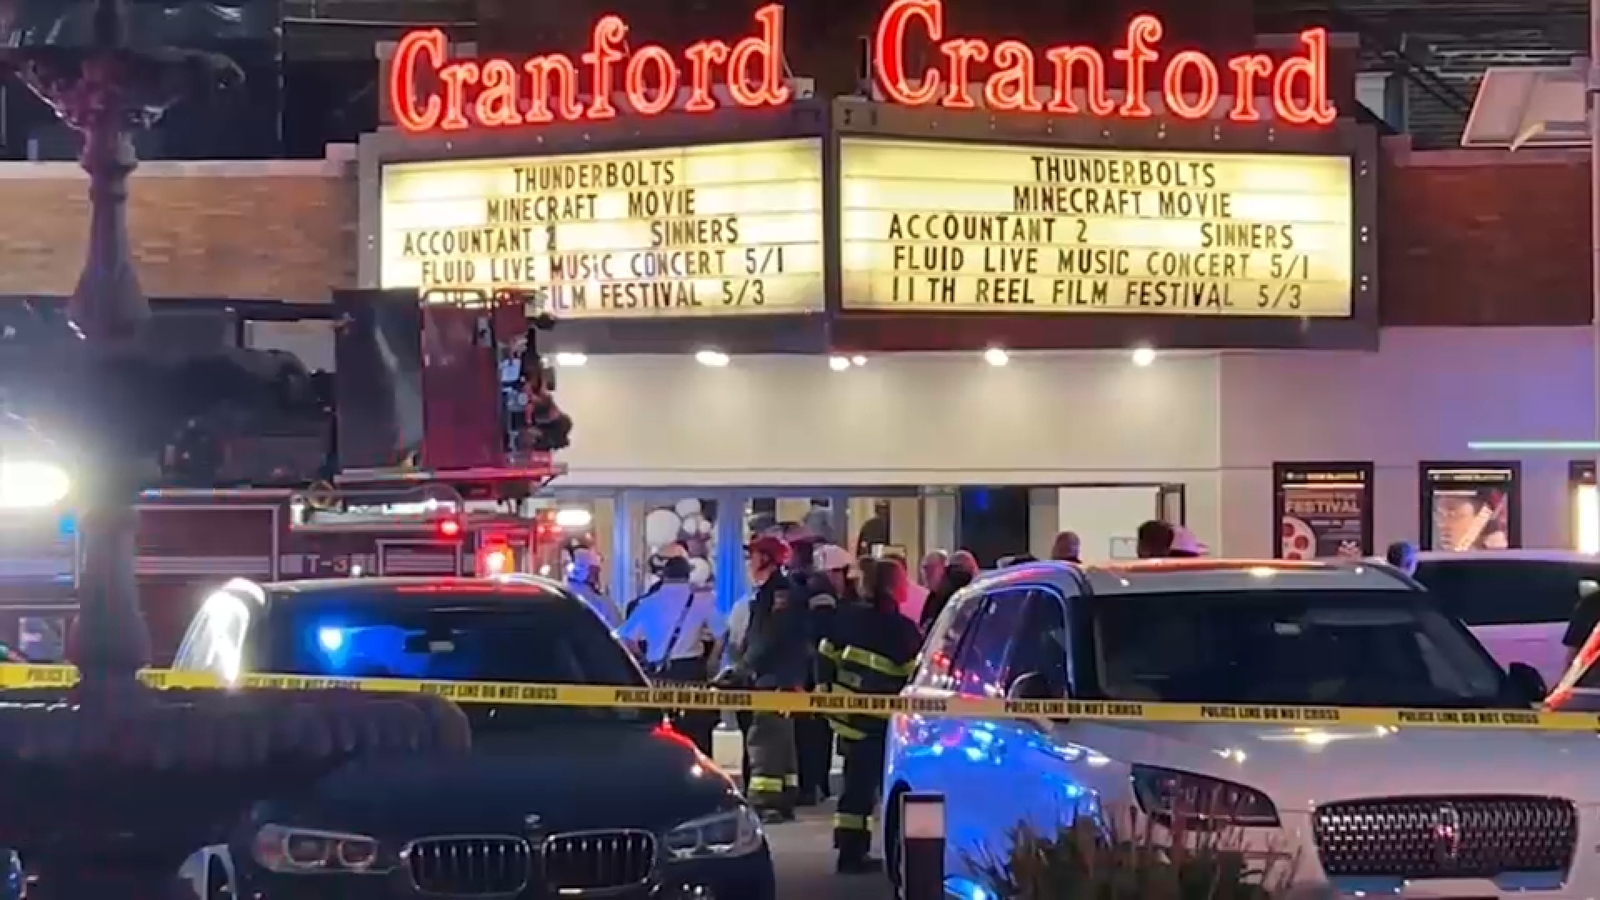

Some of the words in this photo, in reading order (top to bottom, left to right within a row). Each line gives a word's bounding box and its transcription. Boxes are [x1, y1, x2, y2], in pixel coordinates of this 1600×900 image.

[390, 4, 789, 133] Cranford
[874, 0, 1336, 127] Cranford
[513, 160, 675, 192] THUNDERBOLTS
[1031, 156, 1216, 188] THUNDERBOLTS
[487, 193, 597, 222] MINECRAFT
[628, 189, 696, 217] MOVIE
[1013, 186, 1143, 216] MINECRAFT
[1159, 190, 1232, 217] MOVIE
[403, 227, 532, 256] ACCOUNTANT
[650, 217, 739, 247] SINNERS
[888, 214, 1057, 243] ACCOUNTANT
[1076, 219, 1088, 243] 2
[1200, 223, 1294, 250] SINNERS
[422, 259, 476, 284] FLUID
[491, 256, 536, 282] LIVE
[630, 249, 727, 278] CONCERT
[745, 247, 784, 274] 5/1
[893, 245, 965, 272] FLUID
[983, 247, 1040, 275] LIVE
[1057, 249, 1130, 276] MUSIC
[1146, 251, 1249, 279] CONCERT
[1270, 253, 1309, 280] 5/1
[539, 284, 587, 311] FILM
[600, 281, 702, 310] FESTIVAL
[722, 279, 765, 306] 5/3
[976, 278, 1034, 305] REEL
[1052, 280, 1109, 307] FILM
[1125, 282, 1235, 309] FESTIVAL
[1257, 284, 1303, 310] 5/3
[1285, 500, 1361, 513] FESTIVAL
